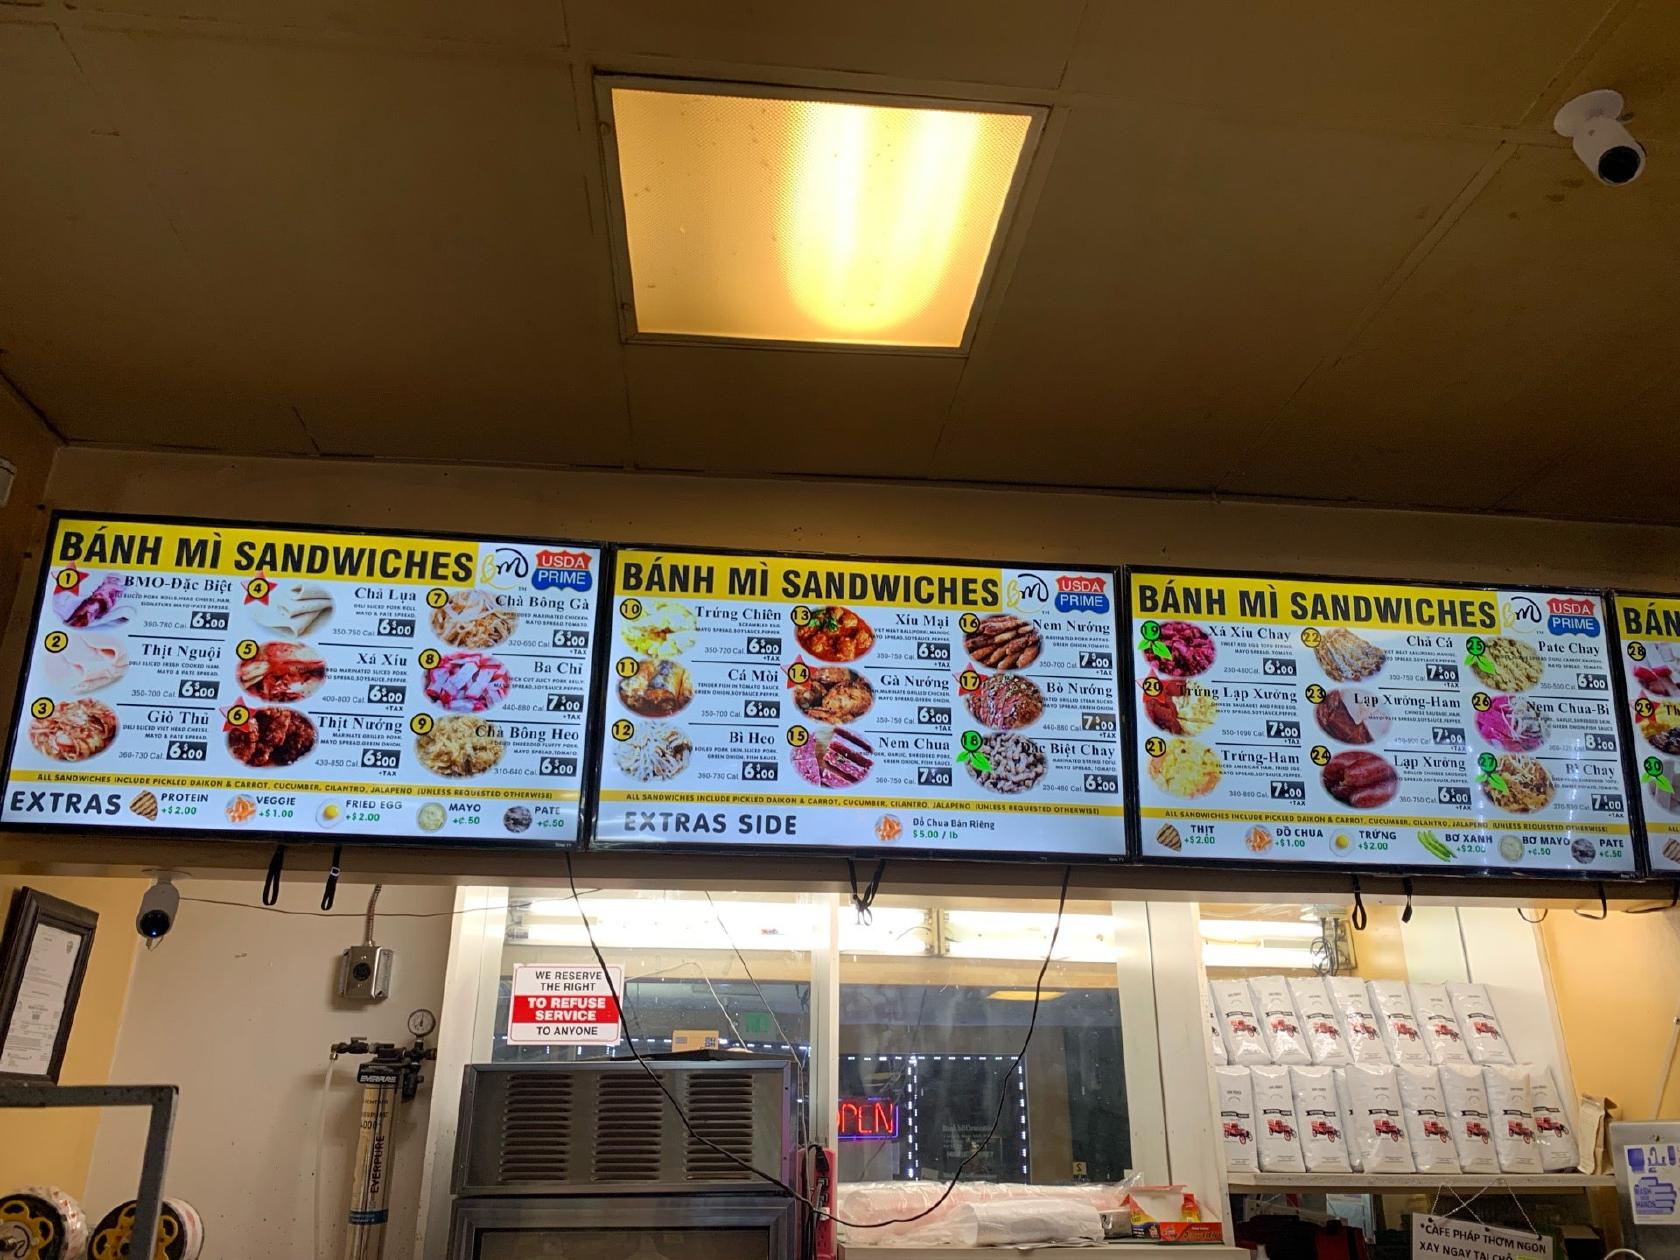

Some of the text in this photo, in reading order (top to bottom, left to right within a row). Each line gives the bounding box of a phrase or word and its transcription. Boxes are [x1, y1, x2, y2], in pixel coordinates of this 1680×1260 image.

[59, 526, 473, 582] BÁNH MÌ SANDWICHES
[542, 555, 586, 569] USDA
[538, 571, 587, 585] PRIME
[622, 556, 999, 608] BÁNH MÌ SANDWICHES
[204, 578, 233, 593] Biệt
[1062, 579, 1101, 592] USDA
[1060, 593, 1104, 607] PRIME
[1138, 579, 1496, 629] BÁNH MÌ SANDWICHES
[622, 603, 640, 614] 10
[1552, 602, 1591, 615] USDA
[962, 617, 978, 629] 16
[1033, 618, 1062, 631] Nem
[1552, 617, 1595, 631] PRIME
[1257, 627, 1292, 643] Chay
[142, 643, 172, 659] Thịt
[1538, 640, 1600, 657] Pate Chay
[534, 661, 552, 673] Ba
[619, 662, 636, 674] 11
[728, 668, 747, 682] Cá
[791, 668, 808, 680] 14
[961, 675, 979, 686] 17
[1144, 680, 1162, 692] 20
[1307, 687, 1325, 699] 23
[1526, 700, 1555, 713] Nem
[318, 716, 348, 734] Thịt
[612, 724, 632, 736] 12
[551, 727, 579, 741] Heo
[750, 731, 775, 745] Heo
[790, 731, 806, 742] 15
[879, 736, 951, 751] Nem Chua
[1148, 741, 1164, 753] 21
[1080, 744, 1116, 760] Chay
[1312, 749, 1330, 761] 24
[1583, 764, 1616, 777] Chay
[37, 773, 52, 781] ALL
[54, 773, 111, 783] SANDWICHES
[114, 776, 150, 785] INCLUDE
[153, 777, 187, 786] PICKLED
[190, 779, 223, 788] DAIKON
[454, 788, 501, 798] REQUESTED
[10, 790, 122, 816] EXTRAS
[161, 792, 209, 803] PROTEIN
[256, 795, 296, 806] VEGGIE
[345, 799, 403, 810] FRIED EGG
[448, 803, 481, 813] MAYO
[624, 811, 797, 835] EXTRAS SIDE
[926, 818, 949, 827] Chua
[1294, 828, 1324, 838] CHUA
[1463, 834, 1493, 844] XANH
[1540, 836, 1571, 846] MAYO
[1600, 838, 1624, 848] PATE
[535, 970, 602, 980] WE RESERVE
[541, 982, 596, 992] THE RIGHT
[528, 997, 606, 1009] TO REFUSE
[535, 1010, 597, 1022] SERVICE
[536, 1026, 598, 1036] TO ANYONE
[836, 1102, 894, 1134] PEN
[370, 1135, 385, 1194] EVERPURE
[1419, 1241, 1472, 1260] XAY NGAY
